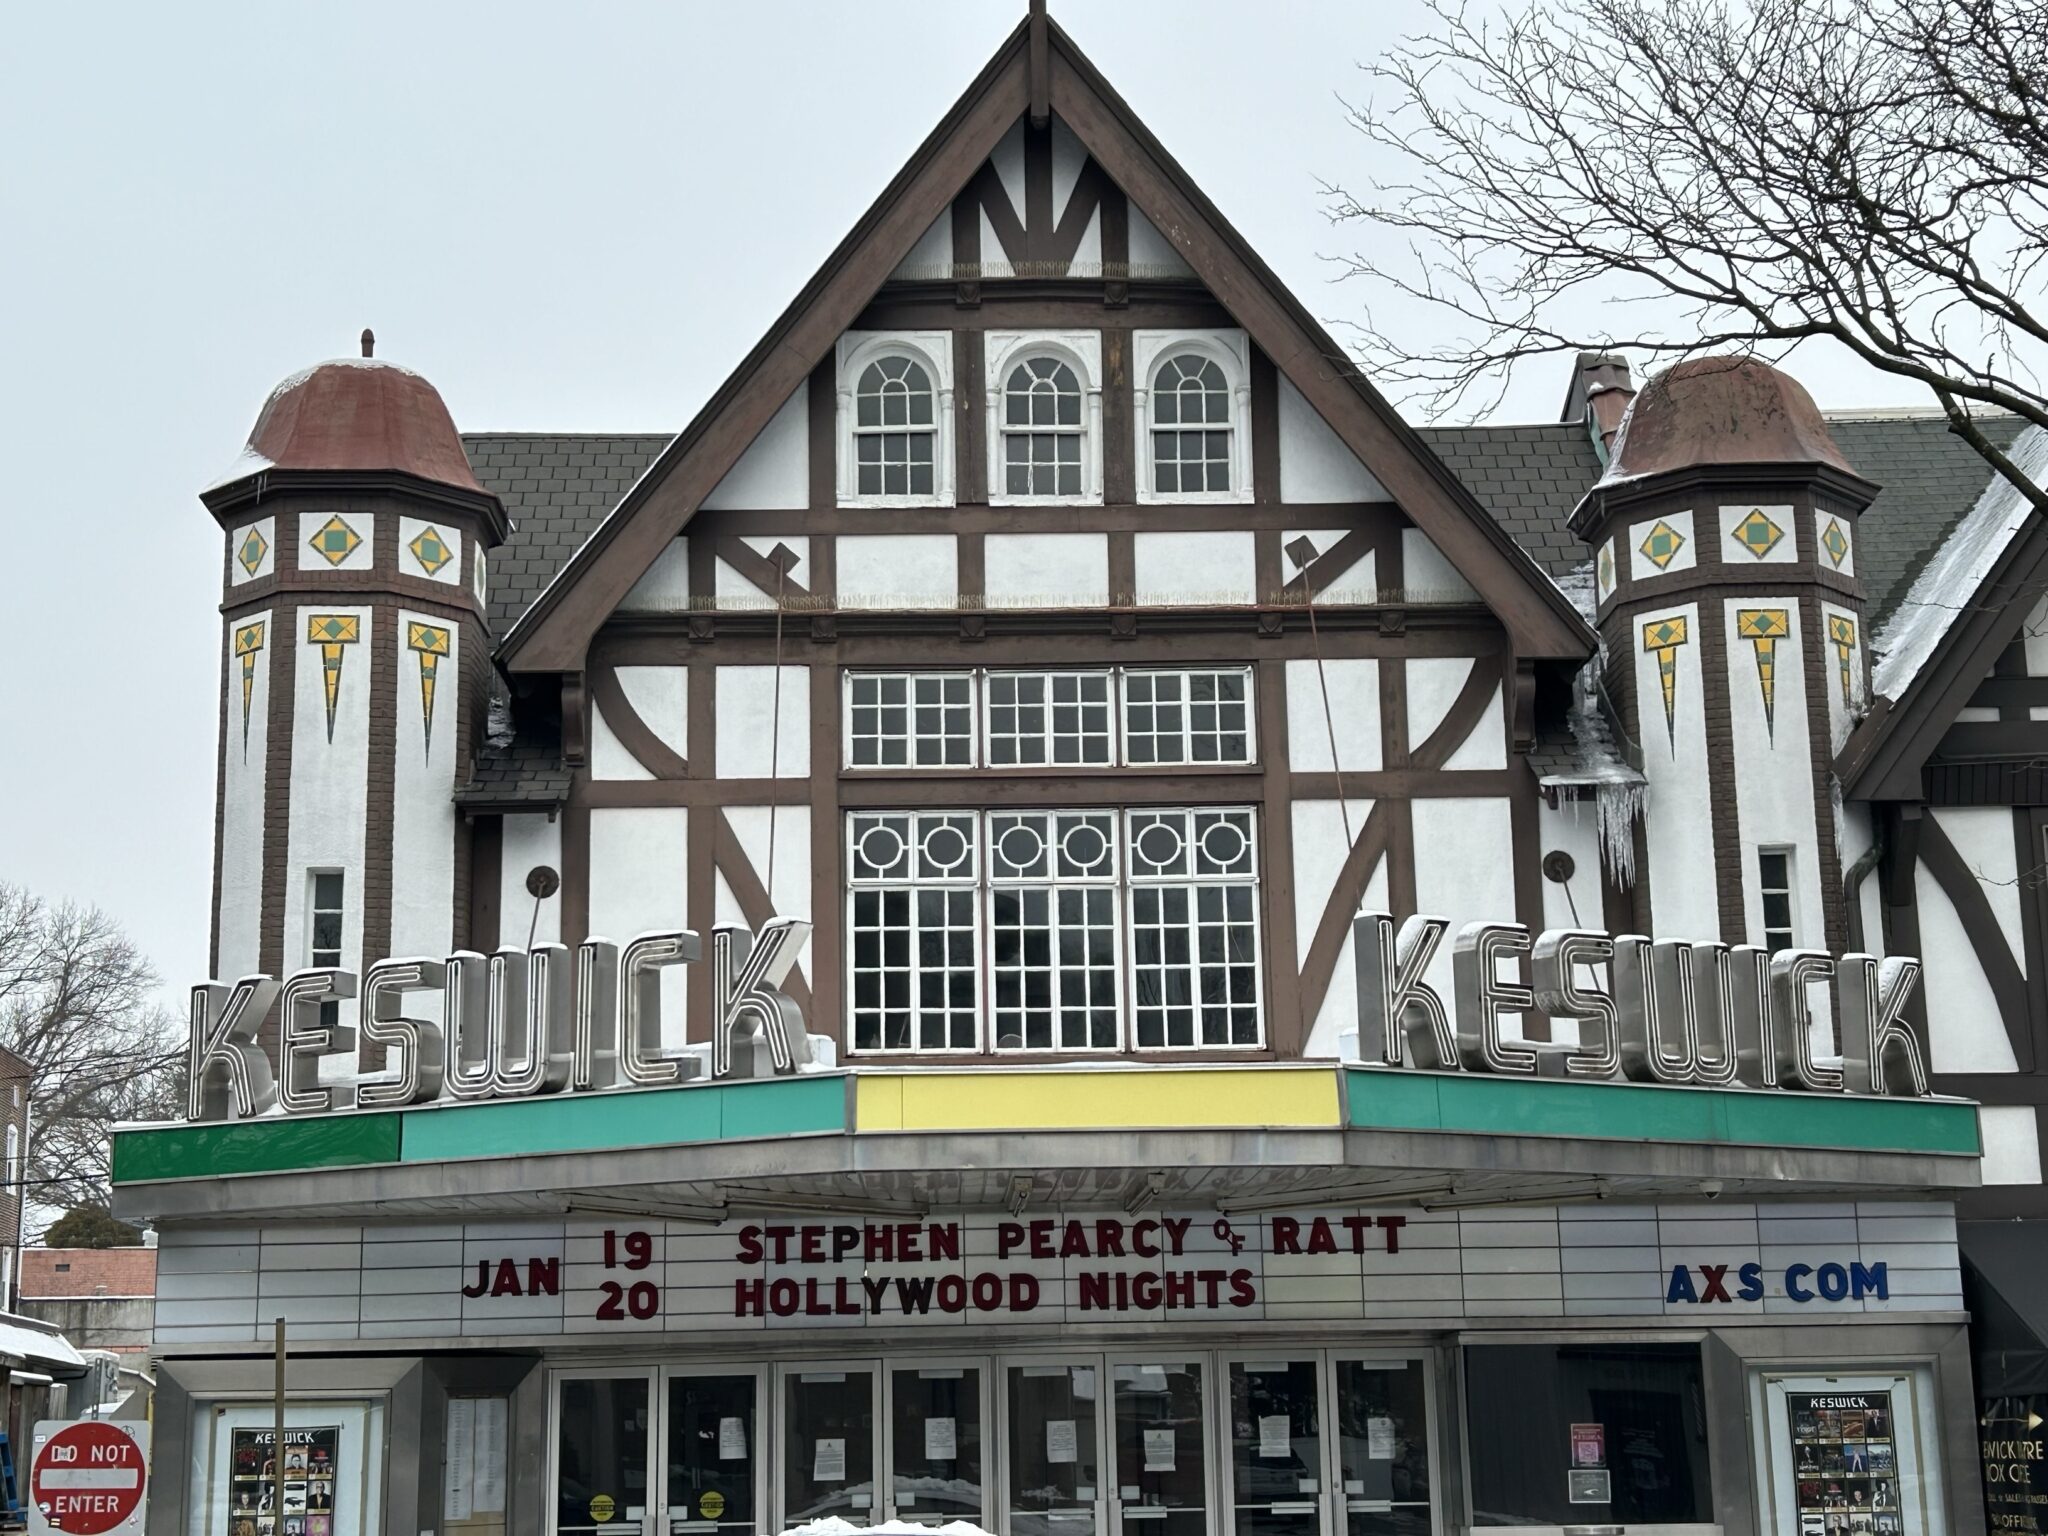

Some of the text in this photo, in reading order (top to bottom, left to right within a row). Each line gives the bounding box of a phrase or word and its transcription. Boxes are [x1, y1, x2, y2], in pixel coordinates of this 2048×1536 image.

[186, 914, 813, 1121] KESWICK
[1353, 909, 1930, 1099] KESWICK
[603, 1230, 653, 1270] 19
[735, 1216, 1406, 1265] STEPHEN PEARCY OF RATT
[462, 1257, 559, 1298] JAN
[735, 1268, 1256, 1318] HOLLYWOOD NIGHTS
[1666, 1262, 1889, 1303] AXS COM
[596, 1280, 659, 1320] 20
[1810, 1397, 1869, 1408] KESWICK
[51, 1445, 130, 1462] DO NOT
[55, 1496, 119, 1513] ENTER
